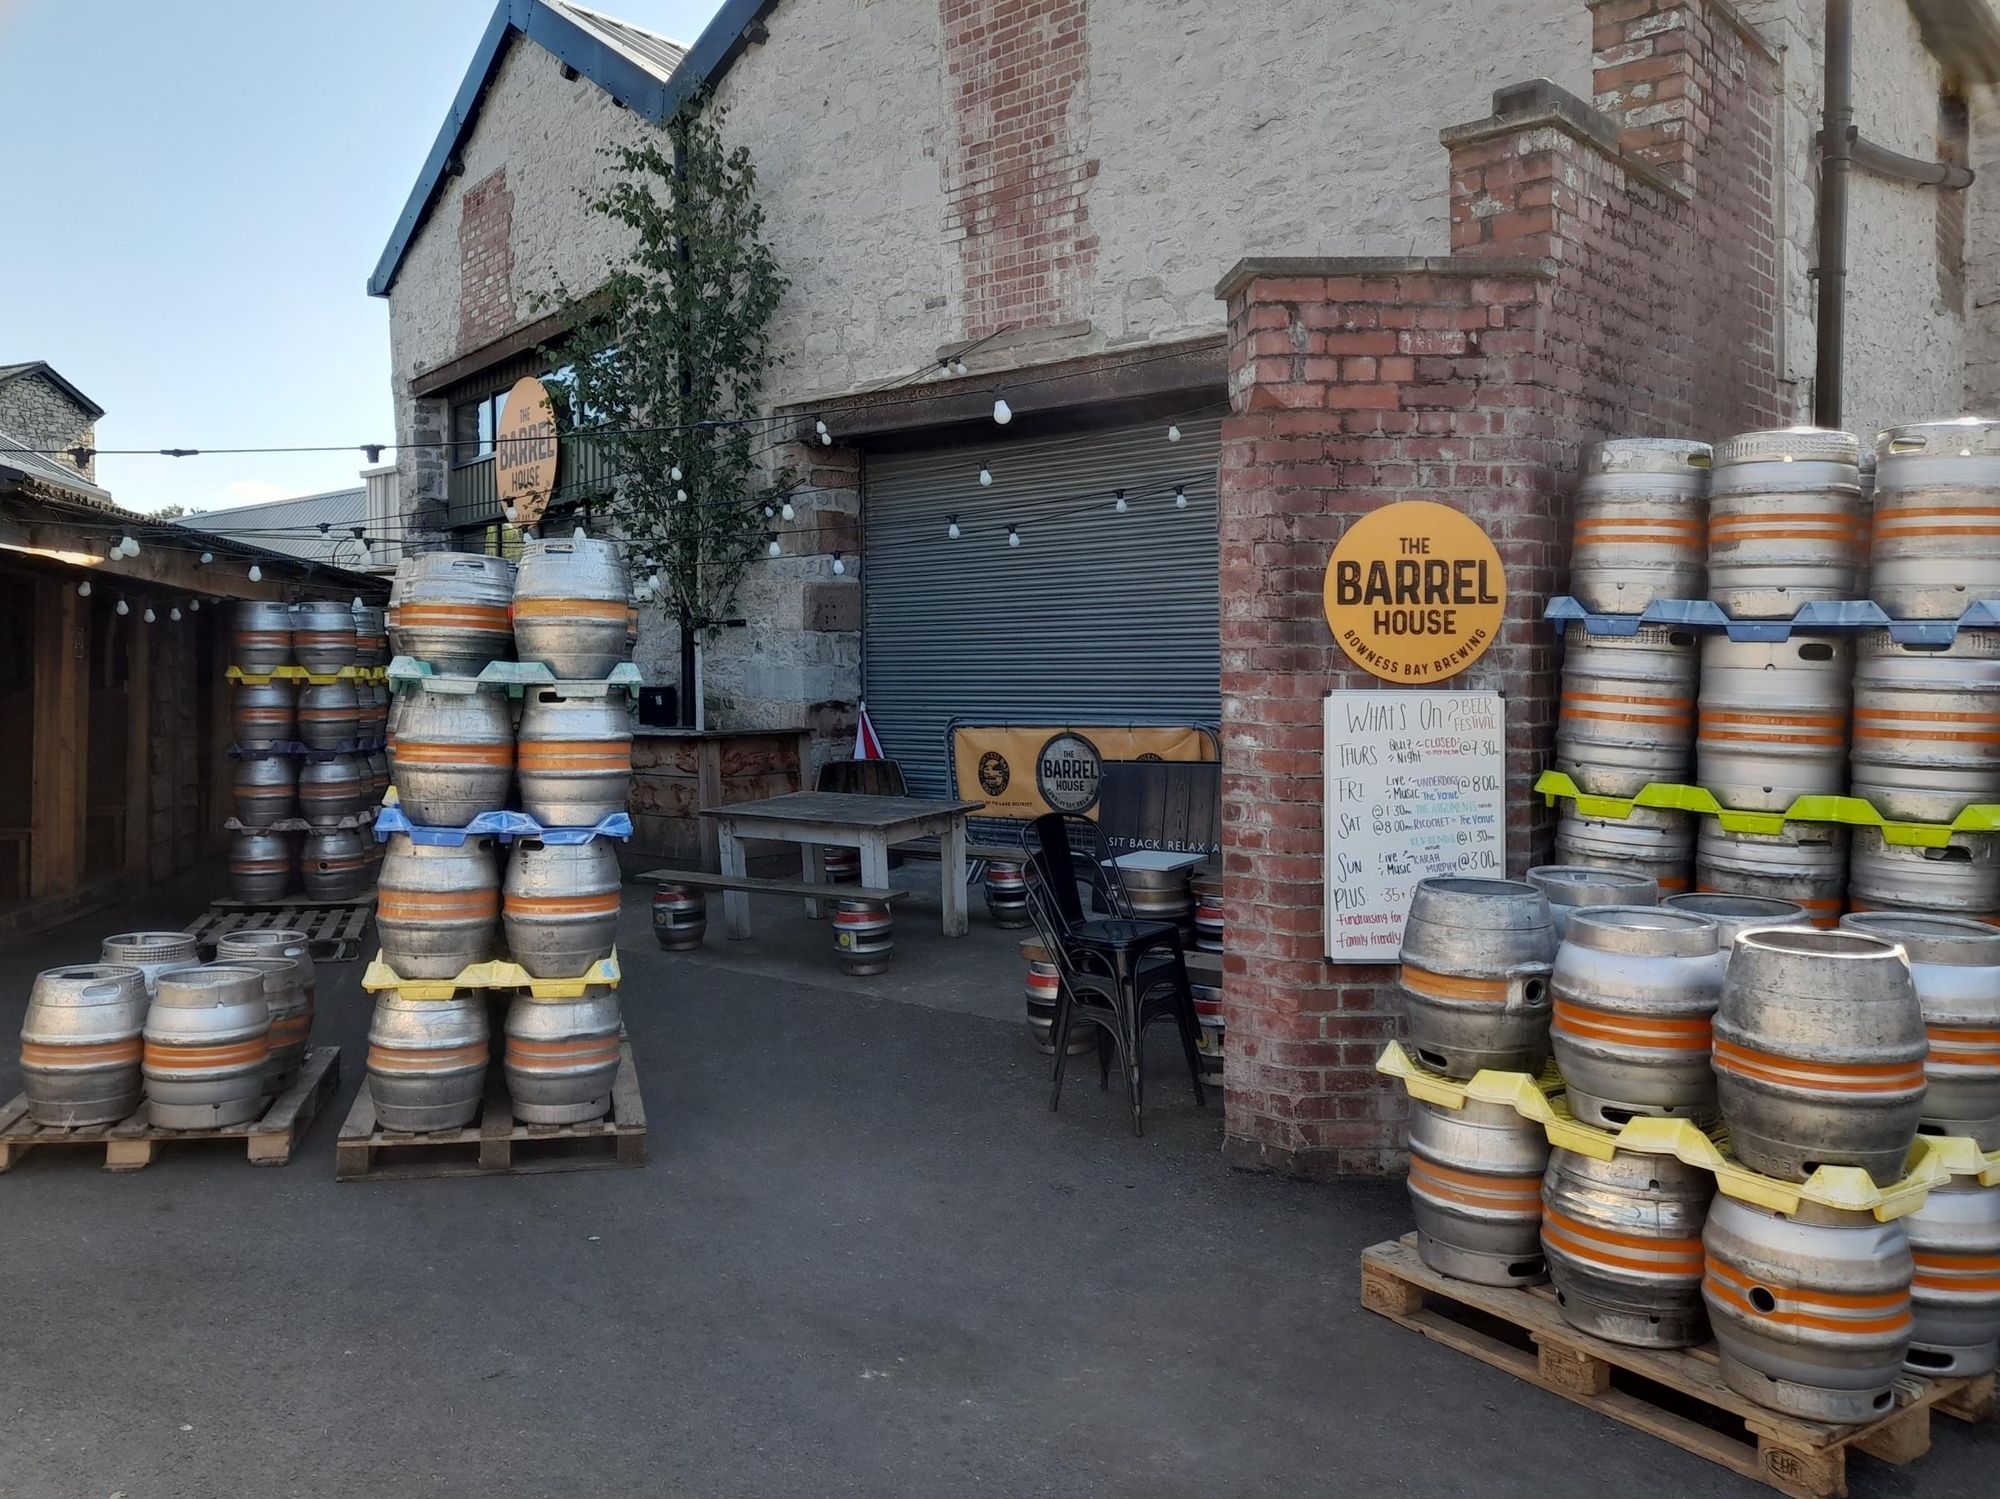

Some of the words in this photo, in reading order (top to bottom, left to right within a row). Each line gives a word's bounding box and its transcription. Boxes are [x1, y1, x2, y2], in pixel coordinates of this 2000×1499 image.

[519, 407, 531, 423] THE
[500, 420, 555, 472] BARREL
[511, 465, 540, 493] HOUSE
[1399, 537, 1431, 555] THE
[1337, 559, 1499, 605] BARREL
[1374, 609, 1457, 636] HOUSE
[1343, 629, 1399, 673] BOWNESS
[1404, 663, 1429, 676] BAY
[1434, 627, 1486, 673] BREWING
[1461, 697, 1498, 715] BEER
[1453, 713, 1498, 732] FESTIVAL
[1064, 750, 1075, 759] THE
[1336, 742, 1378, 768] THURS
[1044, 759, 1098, 780] BARREL
[1056, 780, 1085, 792] HOUSE
[1334, 777, 1365, 803] FRI
[1338, 812, 1362, 839] SAT
[1108, 836, 1125, 847] SIT
[1338, 852, 1363, 883] SUN
